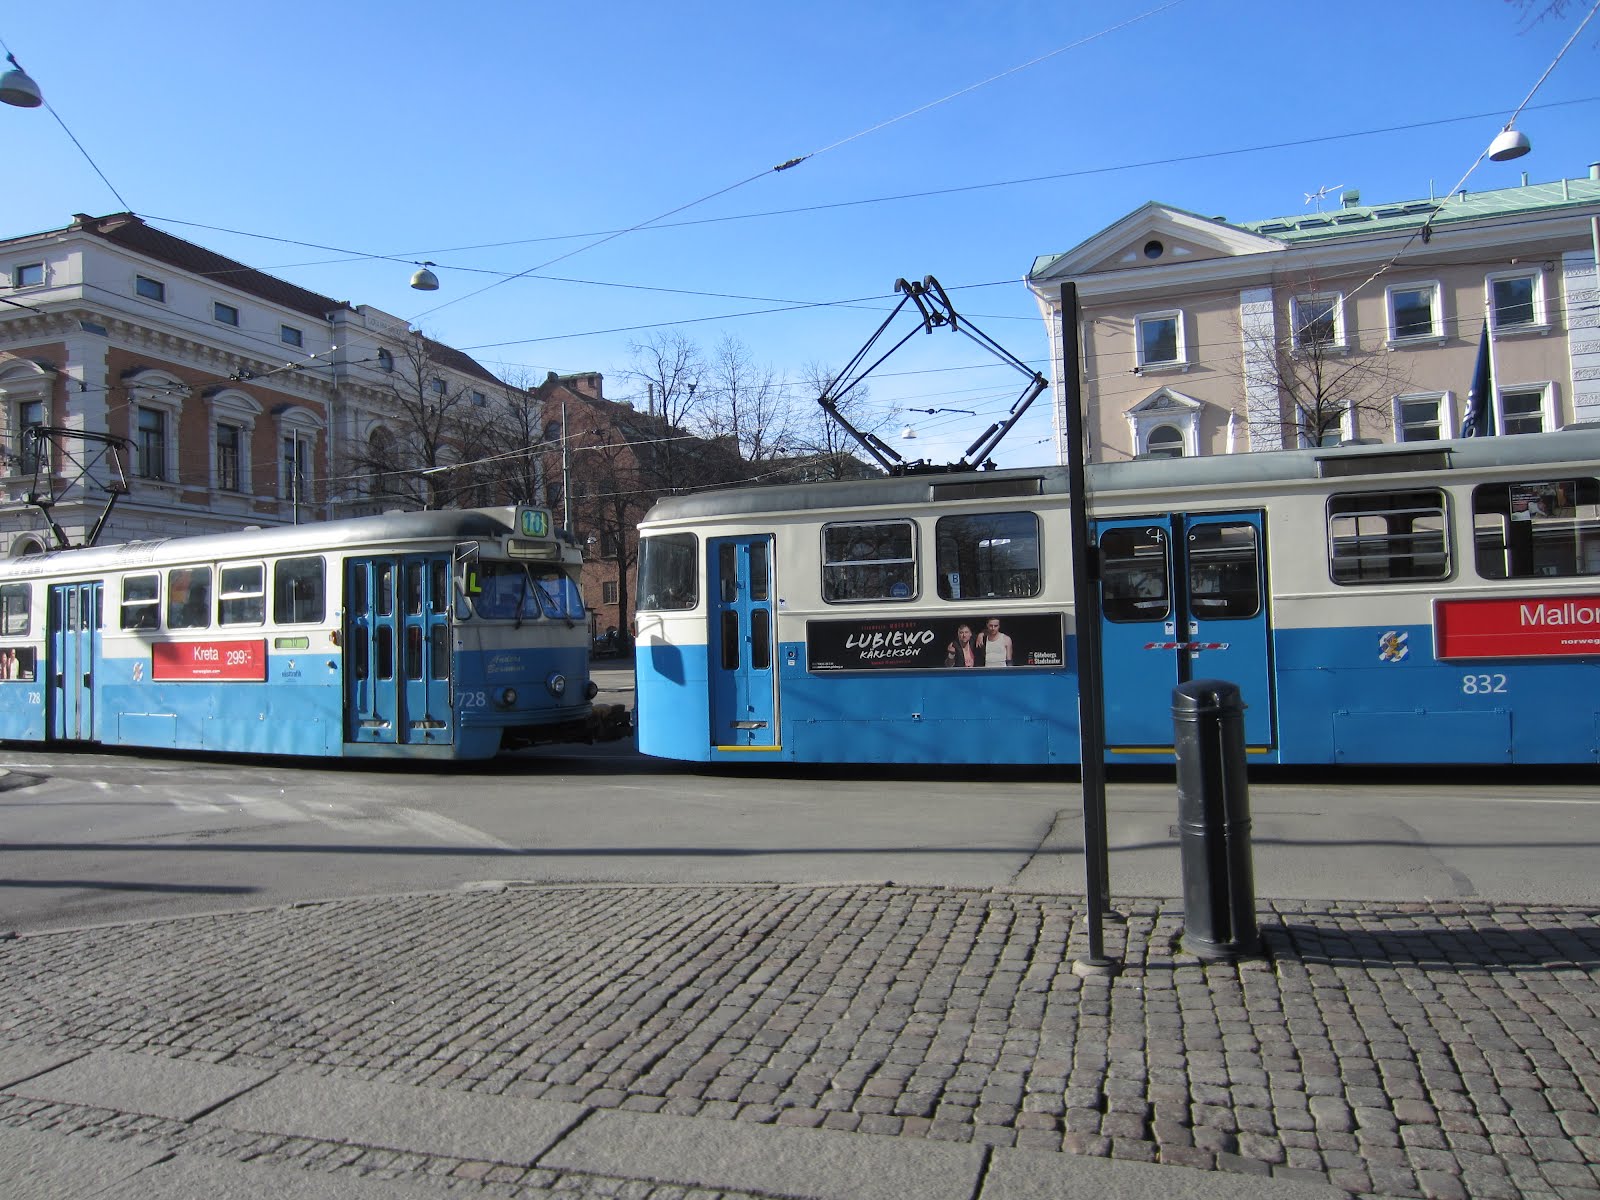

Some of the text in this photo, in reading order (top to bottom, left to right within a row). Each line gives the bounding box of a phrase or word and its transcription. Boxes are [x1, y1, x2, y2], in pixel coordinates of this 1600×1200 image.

[524, 511, 542, 533] 10
[470, 572, 482, 593] L
[952, 574, 959, 584] B
[845, 630, 935, 649] LUBIEWO
[193, 646, 219, 661] Kreta
[859, 645, 921, 659] KÄRLEKSÖN
[1463, 674, 1507, 694] 832
[28, 692, 41, 704] 728
[457, 691, 486, 707] 728
